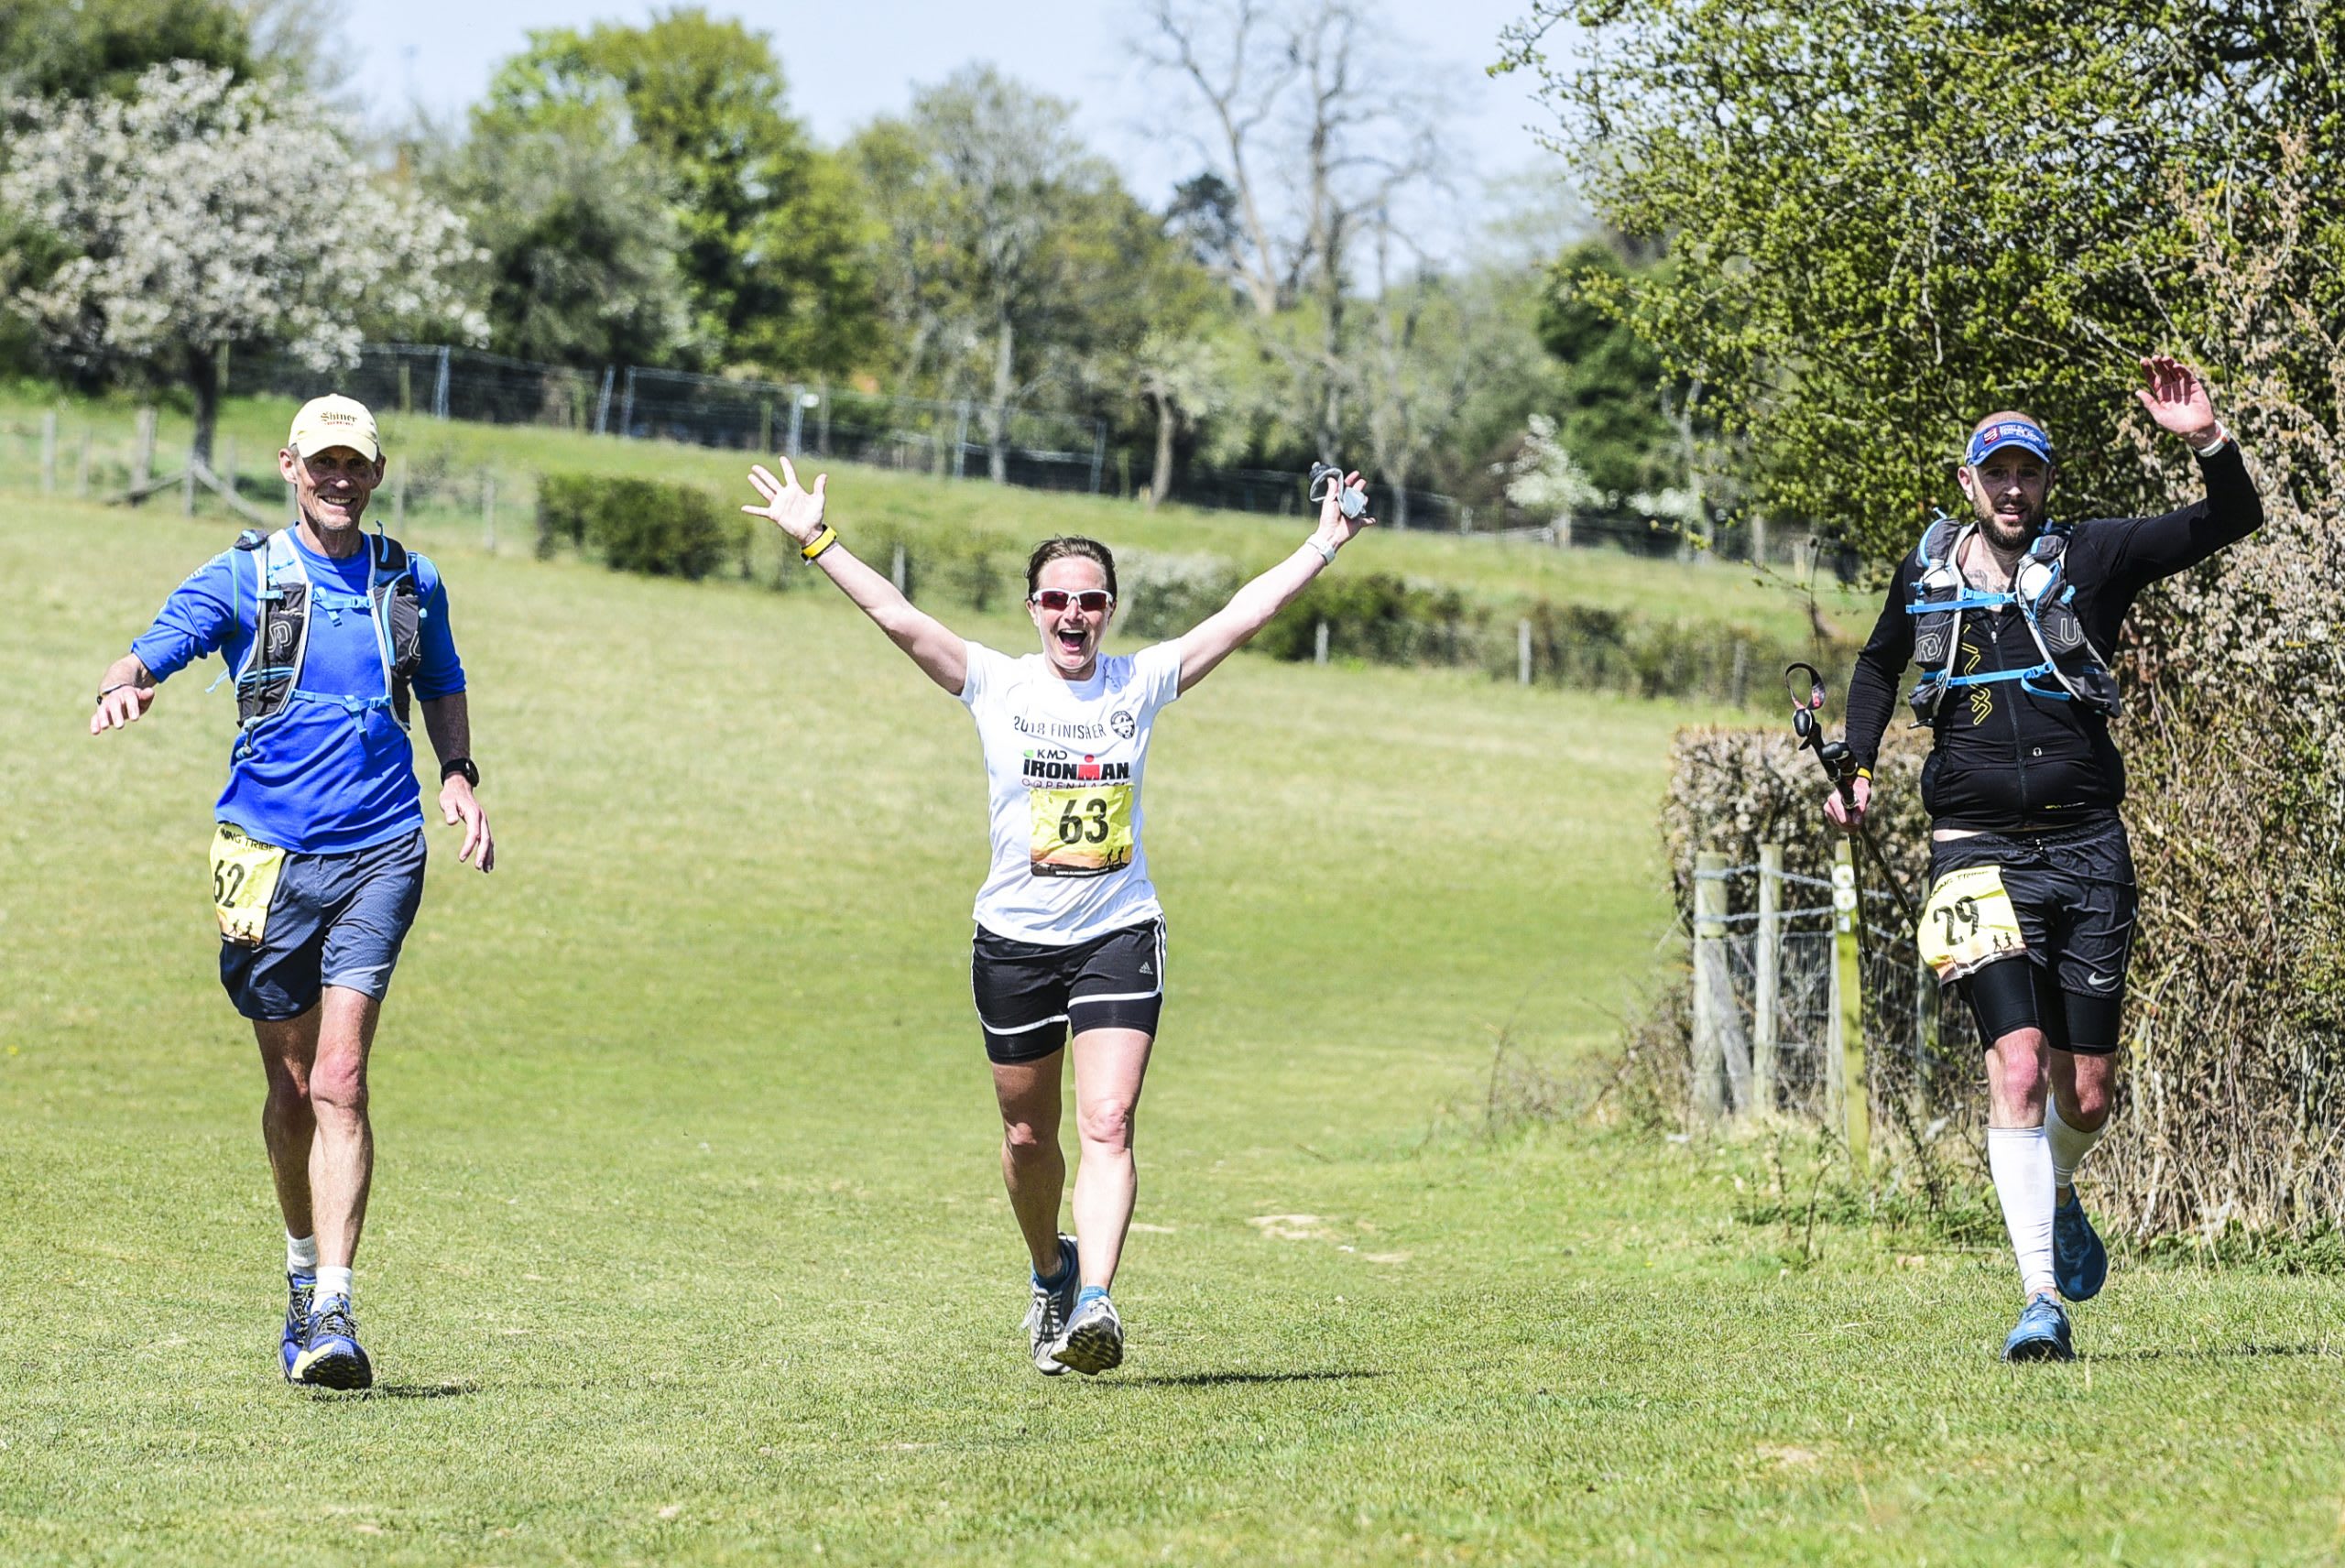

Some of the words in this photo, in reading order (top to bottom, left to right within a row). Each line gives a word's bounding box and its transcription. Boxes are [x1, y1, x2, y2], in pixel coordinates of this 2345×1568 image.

[321, 411, 357, 422] Shiner
[1014, 715, 1045, 735] 2018
[1052, 723, 1107, 739] FINISHER
[1023, 756, 1129, 780] IRONMAN
[1059, 798, 1109, 844] 63
[213, 859, 245, 909] 62
[1933, 896, 1980, 946] 29
